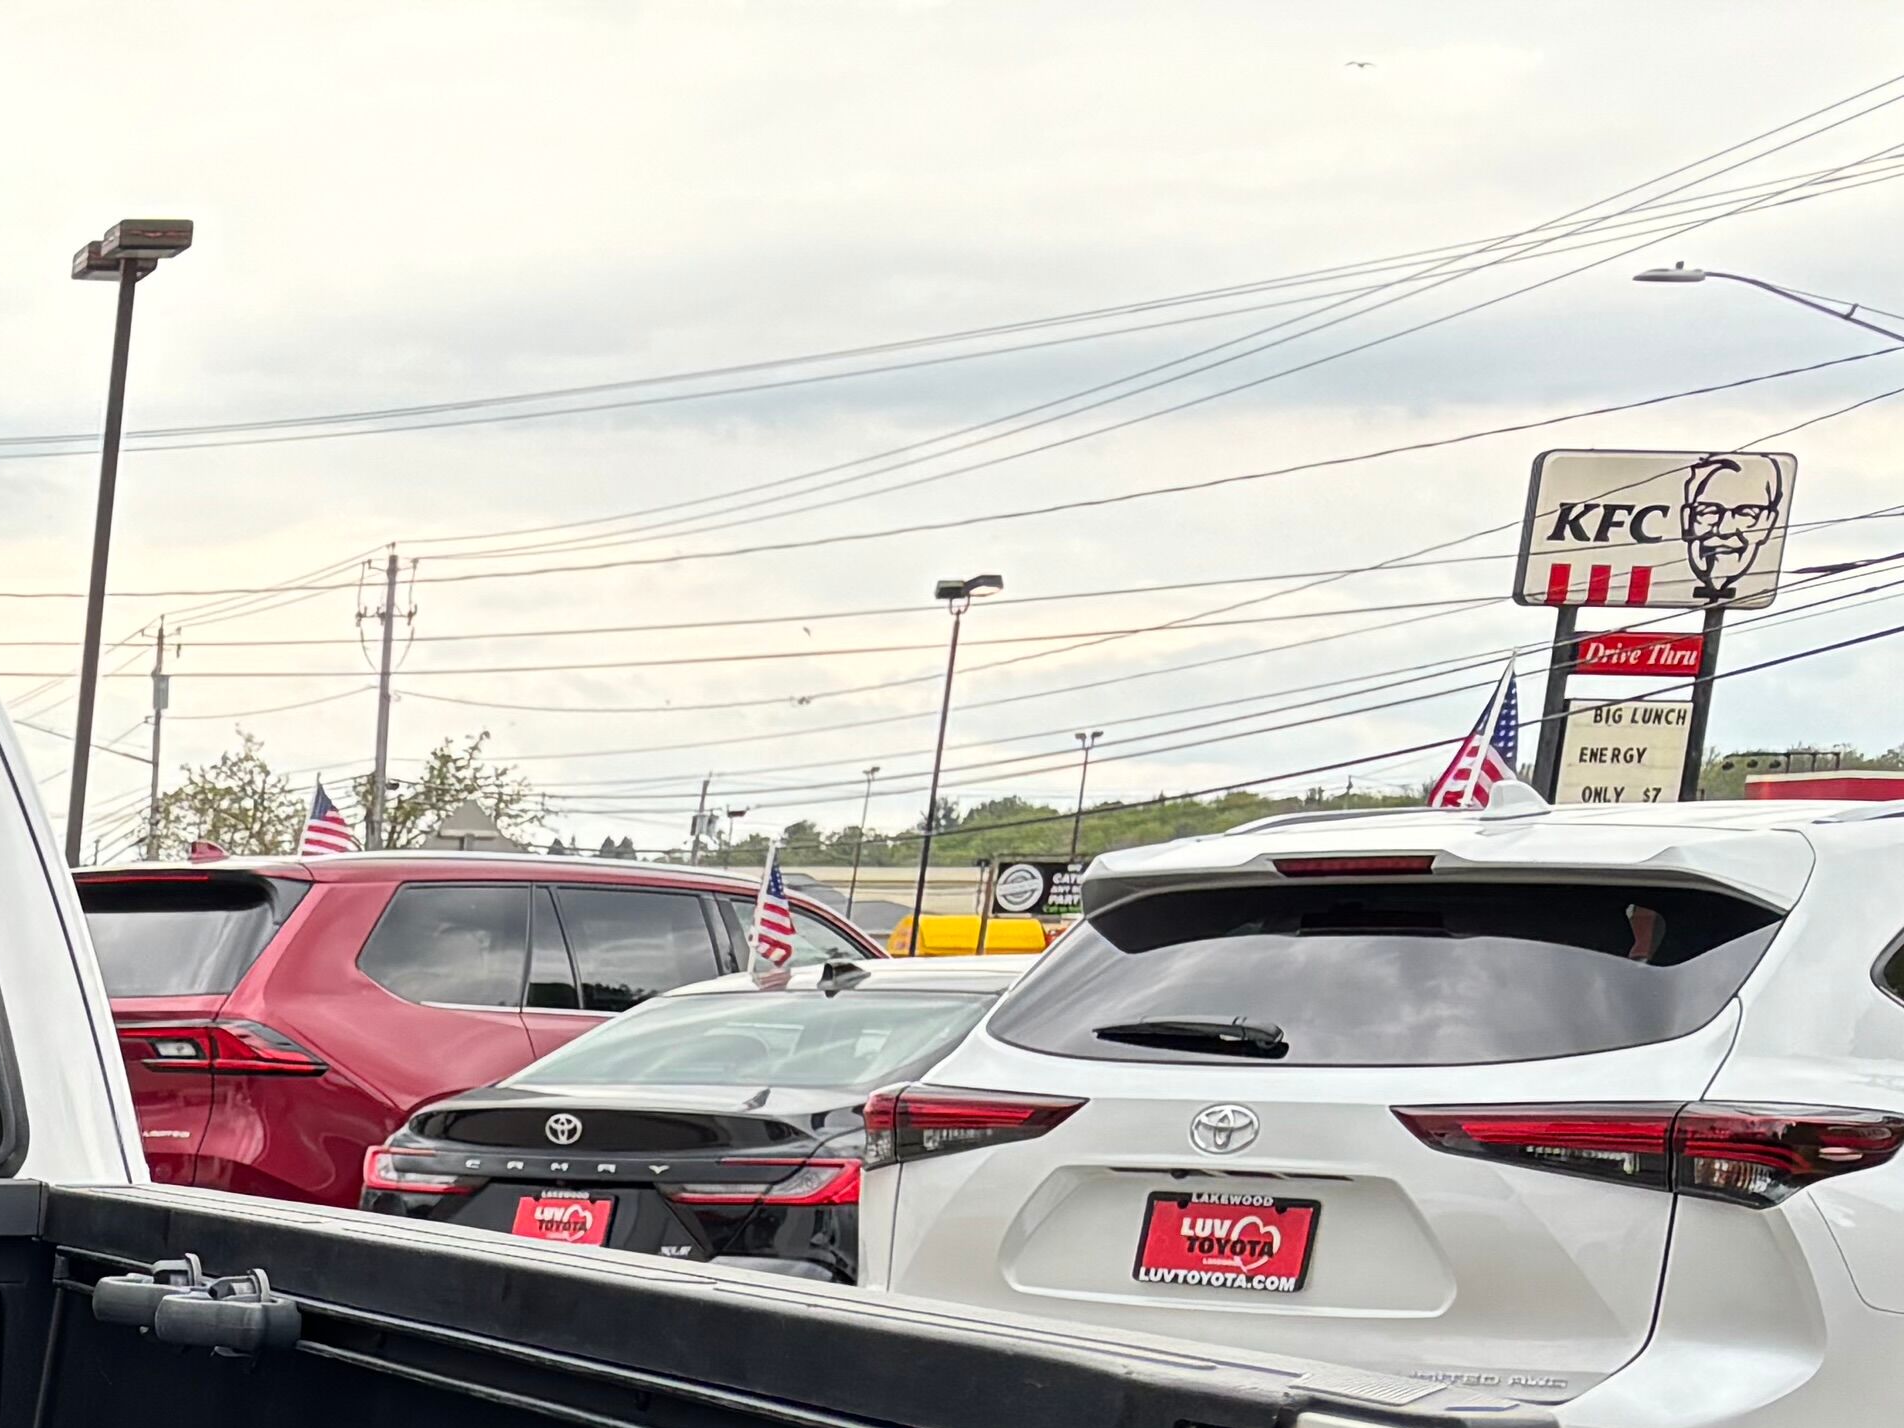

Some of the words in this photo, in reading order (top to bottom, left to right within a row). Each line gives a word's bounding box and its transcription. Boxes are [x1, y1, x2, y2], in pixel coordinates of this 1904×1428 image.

[1546, 502, 1670, 544] KFC
[1585, 642, 1640, 666] Drive
[1646, 643, 1698, 667] Thru
[1593, 708, 1623, 725] BIG
[1630, 708, 1687, 726] LUNCH
[1579, 747, 1647, 764] ENERGY
[1581, 787, 1624, 804] ONLY
[1642, 787, 1662, 804] $7
[465, 1158, 670, 1174] CAMRY
[1191, 1192, 1274, 1207] LAKEWOOD
[534, 1206, 565, 1220] LUV
[538, 1219, 588, 1232] TOYOTA
[1180, 1217, 1232, 1238] LUV
[1186, 1236, 1274, 1258] TOYOTA
[1138, 1266, 1297, 1292] LUVTOYOTA.COM
